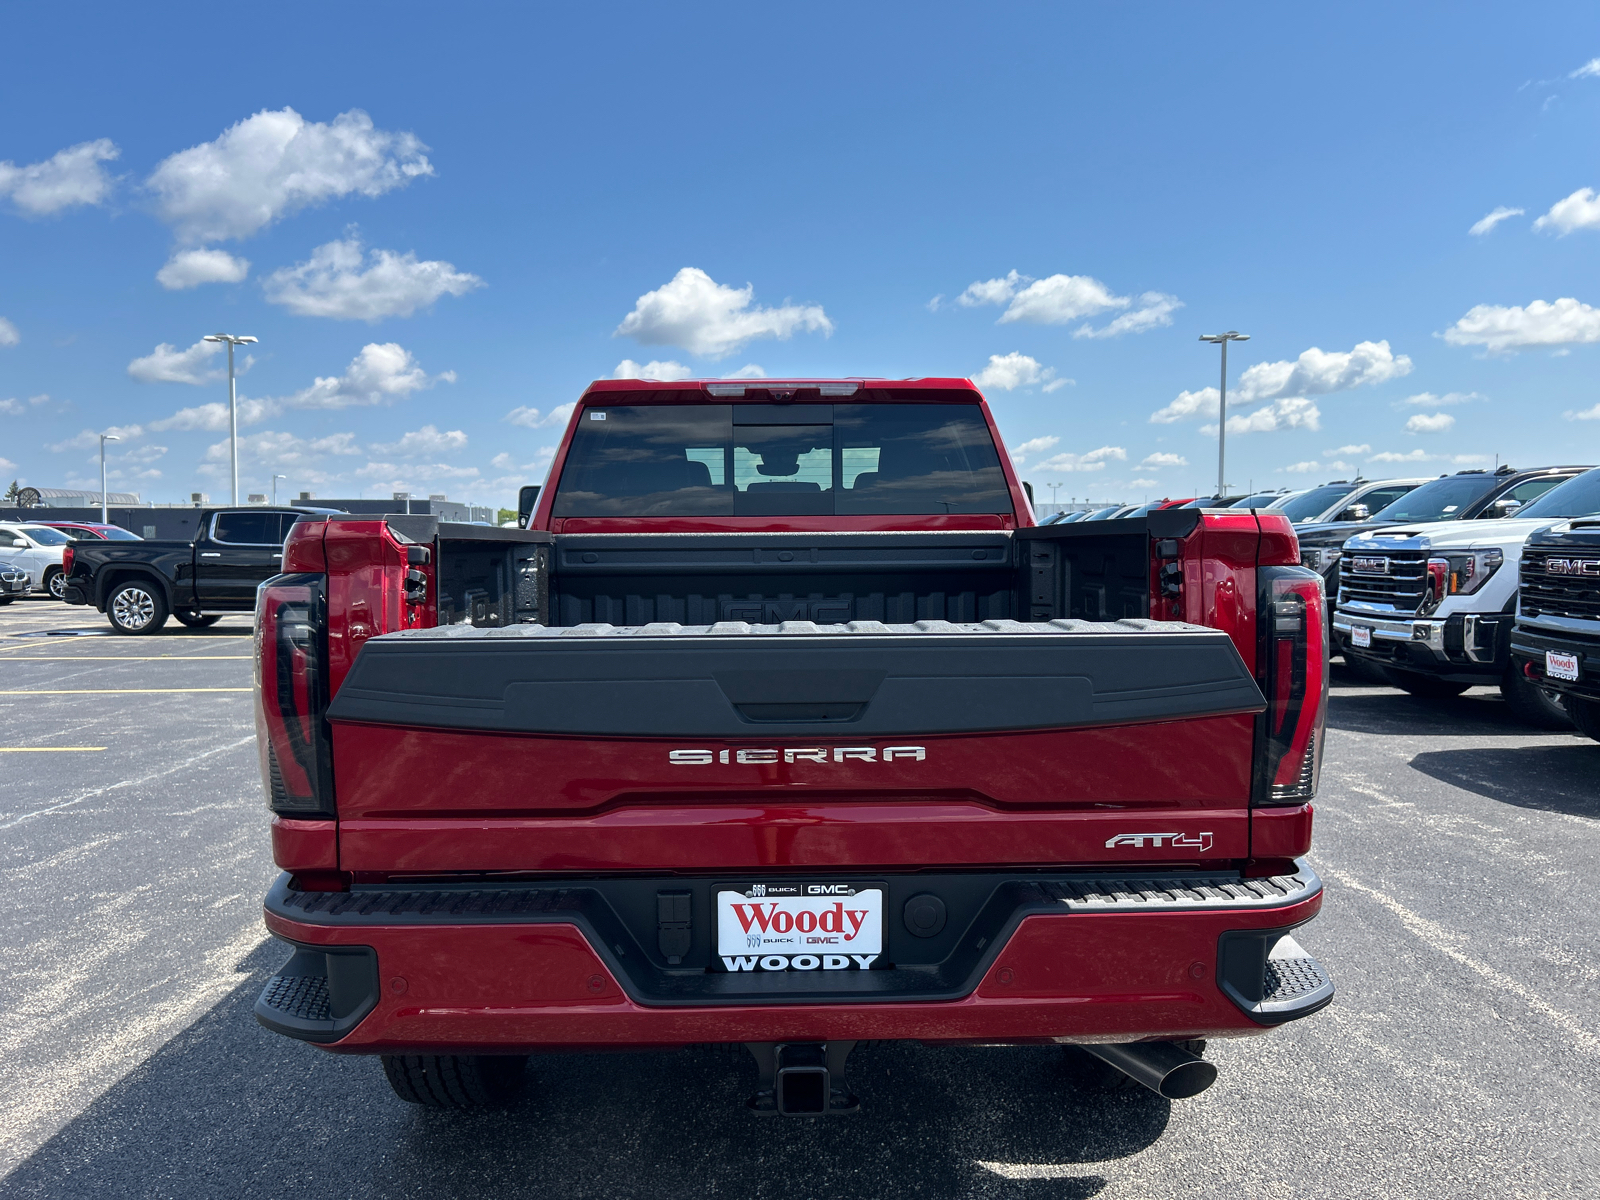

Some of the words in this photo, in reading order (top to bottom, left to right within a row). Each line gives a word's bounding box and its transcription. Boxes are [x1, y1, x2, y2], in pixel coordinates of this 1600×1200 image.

[1546, 559, 1600, 575] GMC
[723, 603, 849, 623] GMC
[1549, 655, 1575, 671] Woody
[1546, 670, 1578, 681] WOODY
[669, 746, 926, 765] SIERRA
[1105, 832, 1213, 852] AT4
[807, 885, 849, 894] GMC
[730, 902, 869, 941] Woody
[721, 955, 879, 972] WOODY
